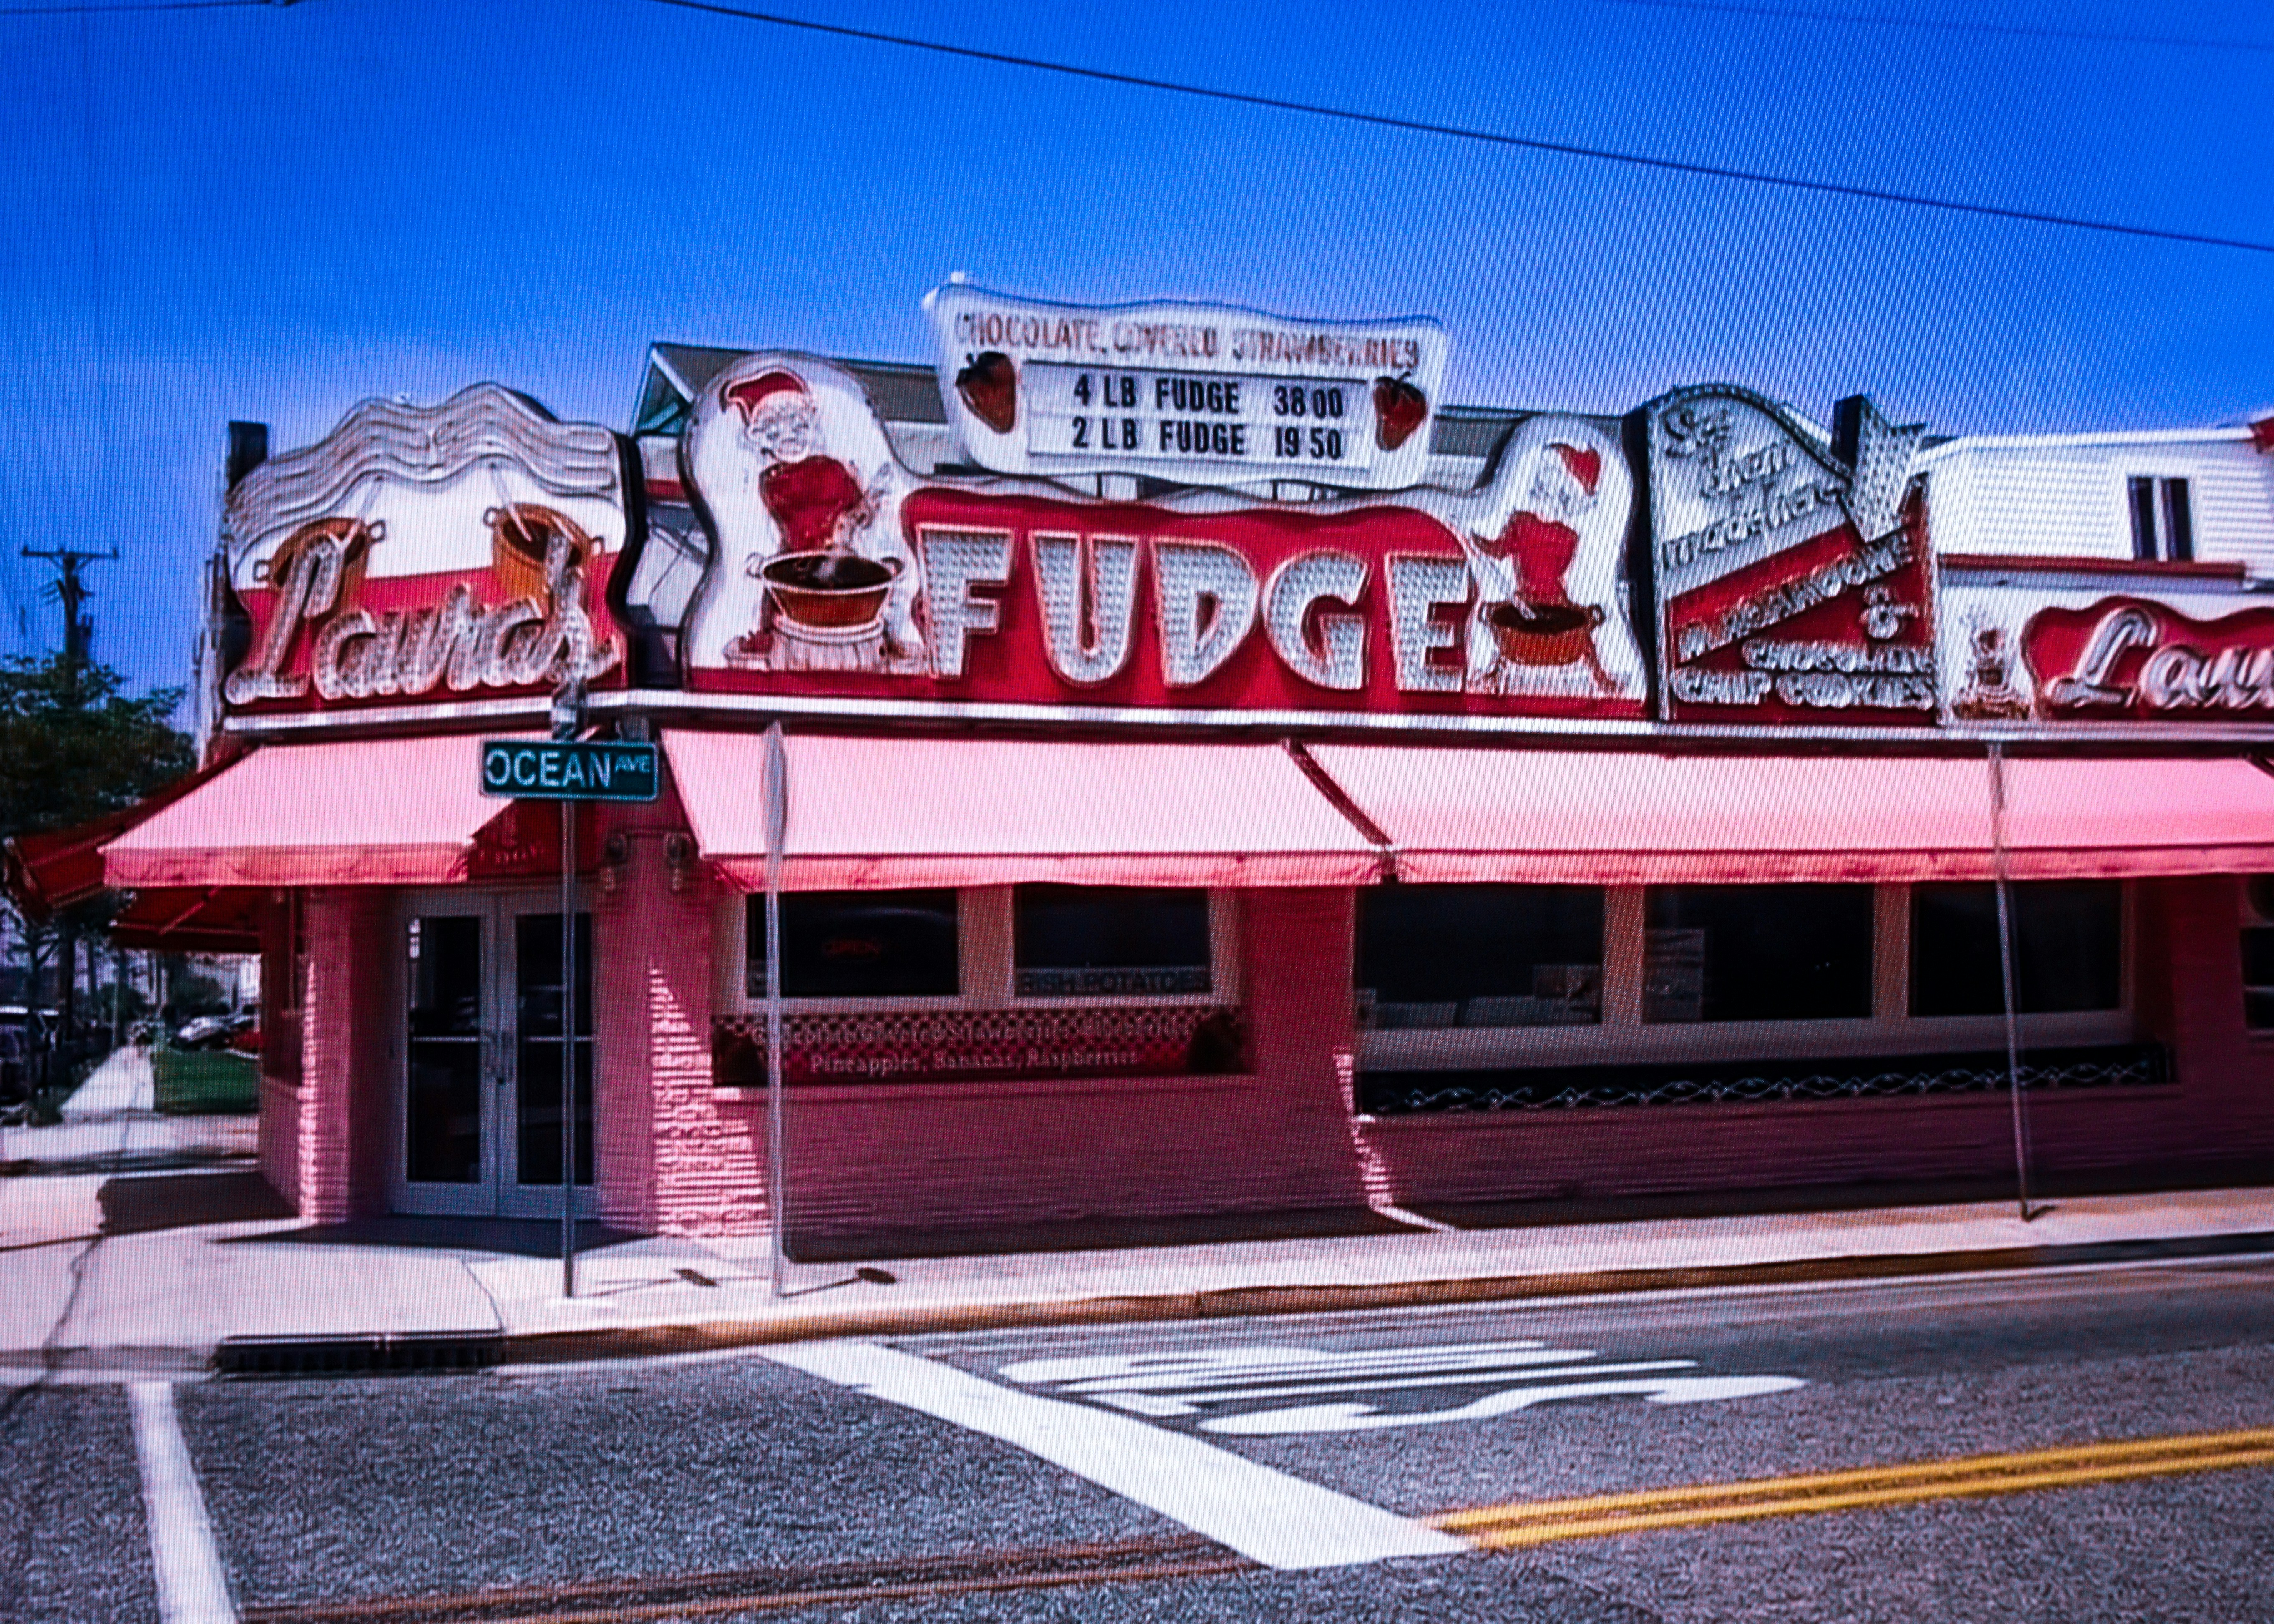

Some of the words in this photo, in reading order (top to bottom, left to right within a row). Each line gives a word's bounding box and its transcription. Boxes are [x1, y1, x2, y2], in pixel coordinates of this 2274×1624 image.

[955, 310, 1100, 353] CHOCOLATE
[1112, 321, 1217, 359] COVERED
[1232, 327, 1419, 370] STRAWBERRIES
[1074, 373, 1091, 407] 4
[1104, 375, 1137, 408] LB
[1155, 377, 1240, 414] FUDGE
[1072, 416, 1089, 448] 2
[1102, 417, 1138, 450] LB
[1160, 420, 1246, 455] FUDGE
[916, 522, 1472, 692] FUDGE
[1669, 666, 1773, 706] CHIP
[1775, 670, 1937, 711] COOKIES
[485, 750, 611, 788] OCEAN
[614, 754, 652, 774] AVE
